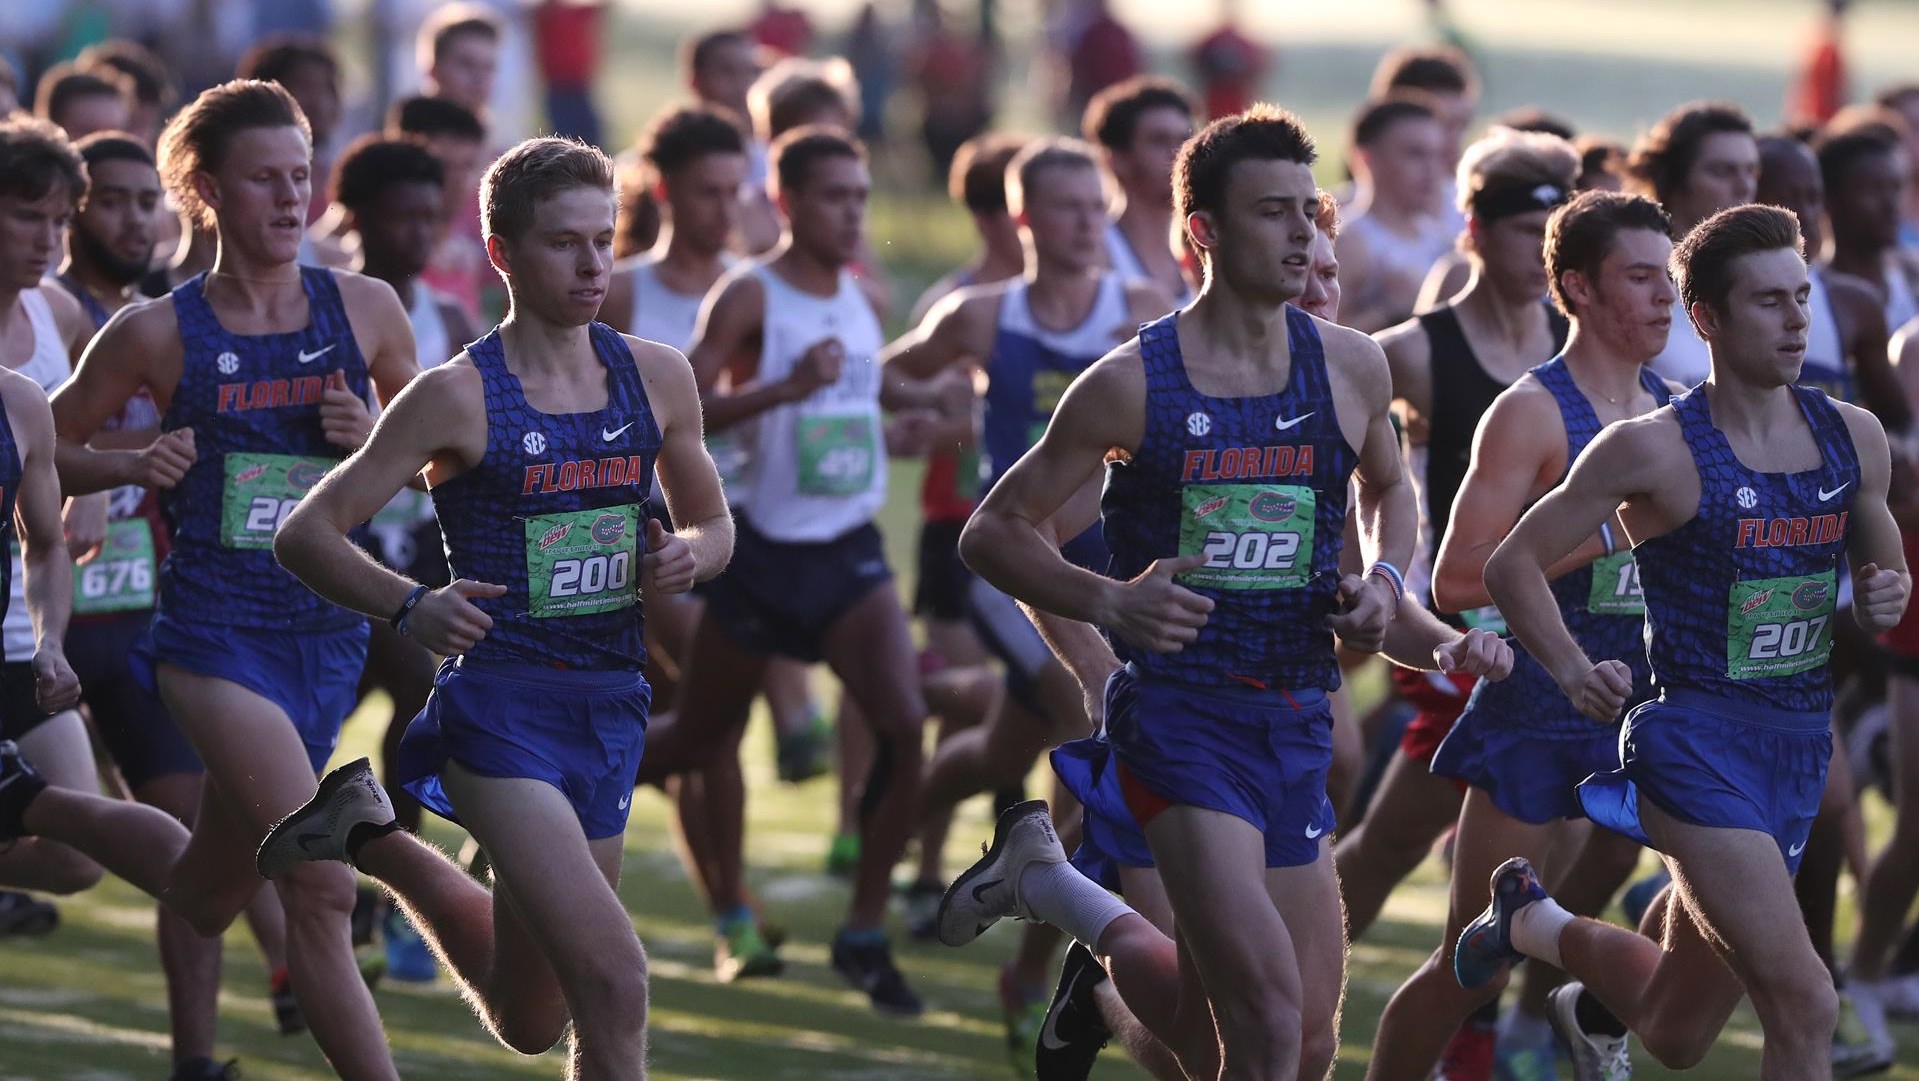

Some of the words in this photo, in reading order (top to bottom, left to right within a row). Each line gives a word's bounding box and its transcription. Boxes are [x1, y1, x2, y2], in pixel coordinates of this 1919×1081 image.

[523, 432, 546, 455] SEC
[1187, 412, 1210, 436] SEC
[520, 456, 641, 496] FLORIDA
[1181, 445, 1314, 481] FLORIDA
[1736, 487, 1757, 509] SEC
[1201, 531, 1301, 570] 202
[82, 557, 151, 598] 676
[549, 551, 630, 598] 200
[1748, 614, 1829, 660] 207
